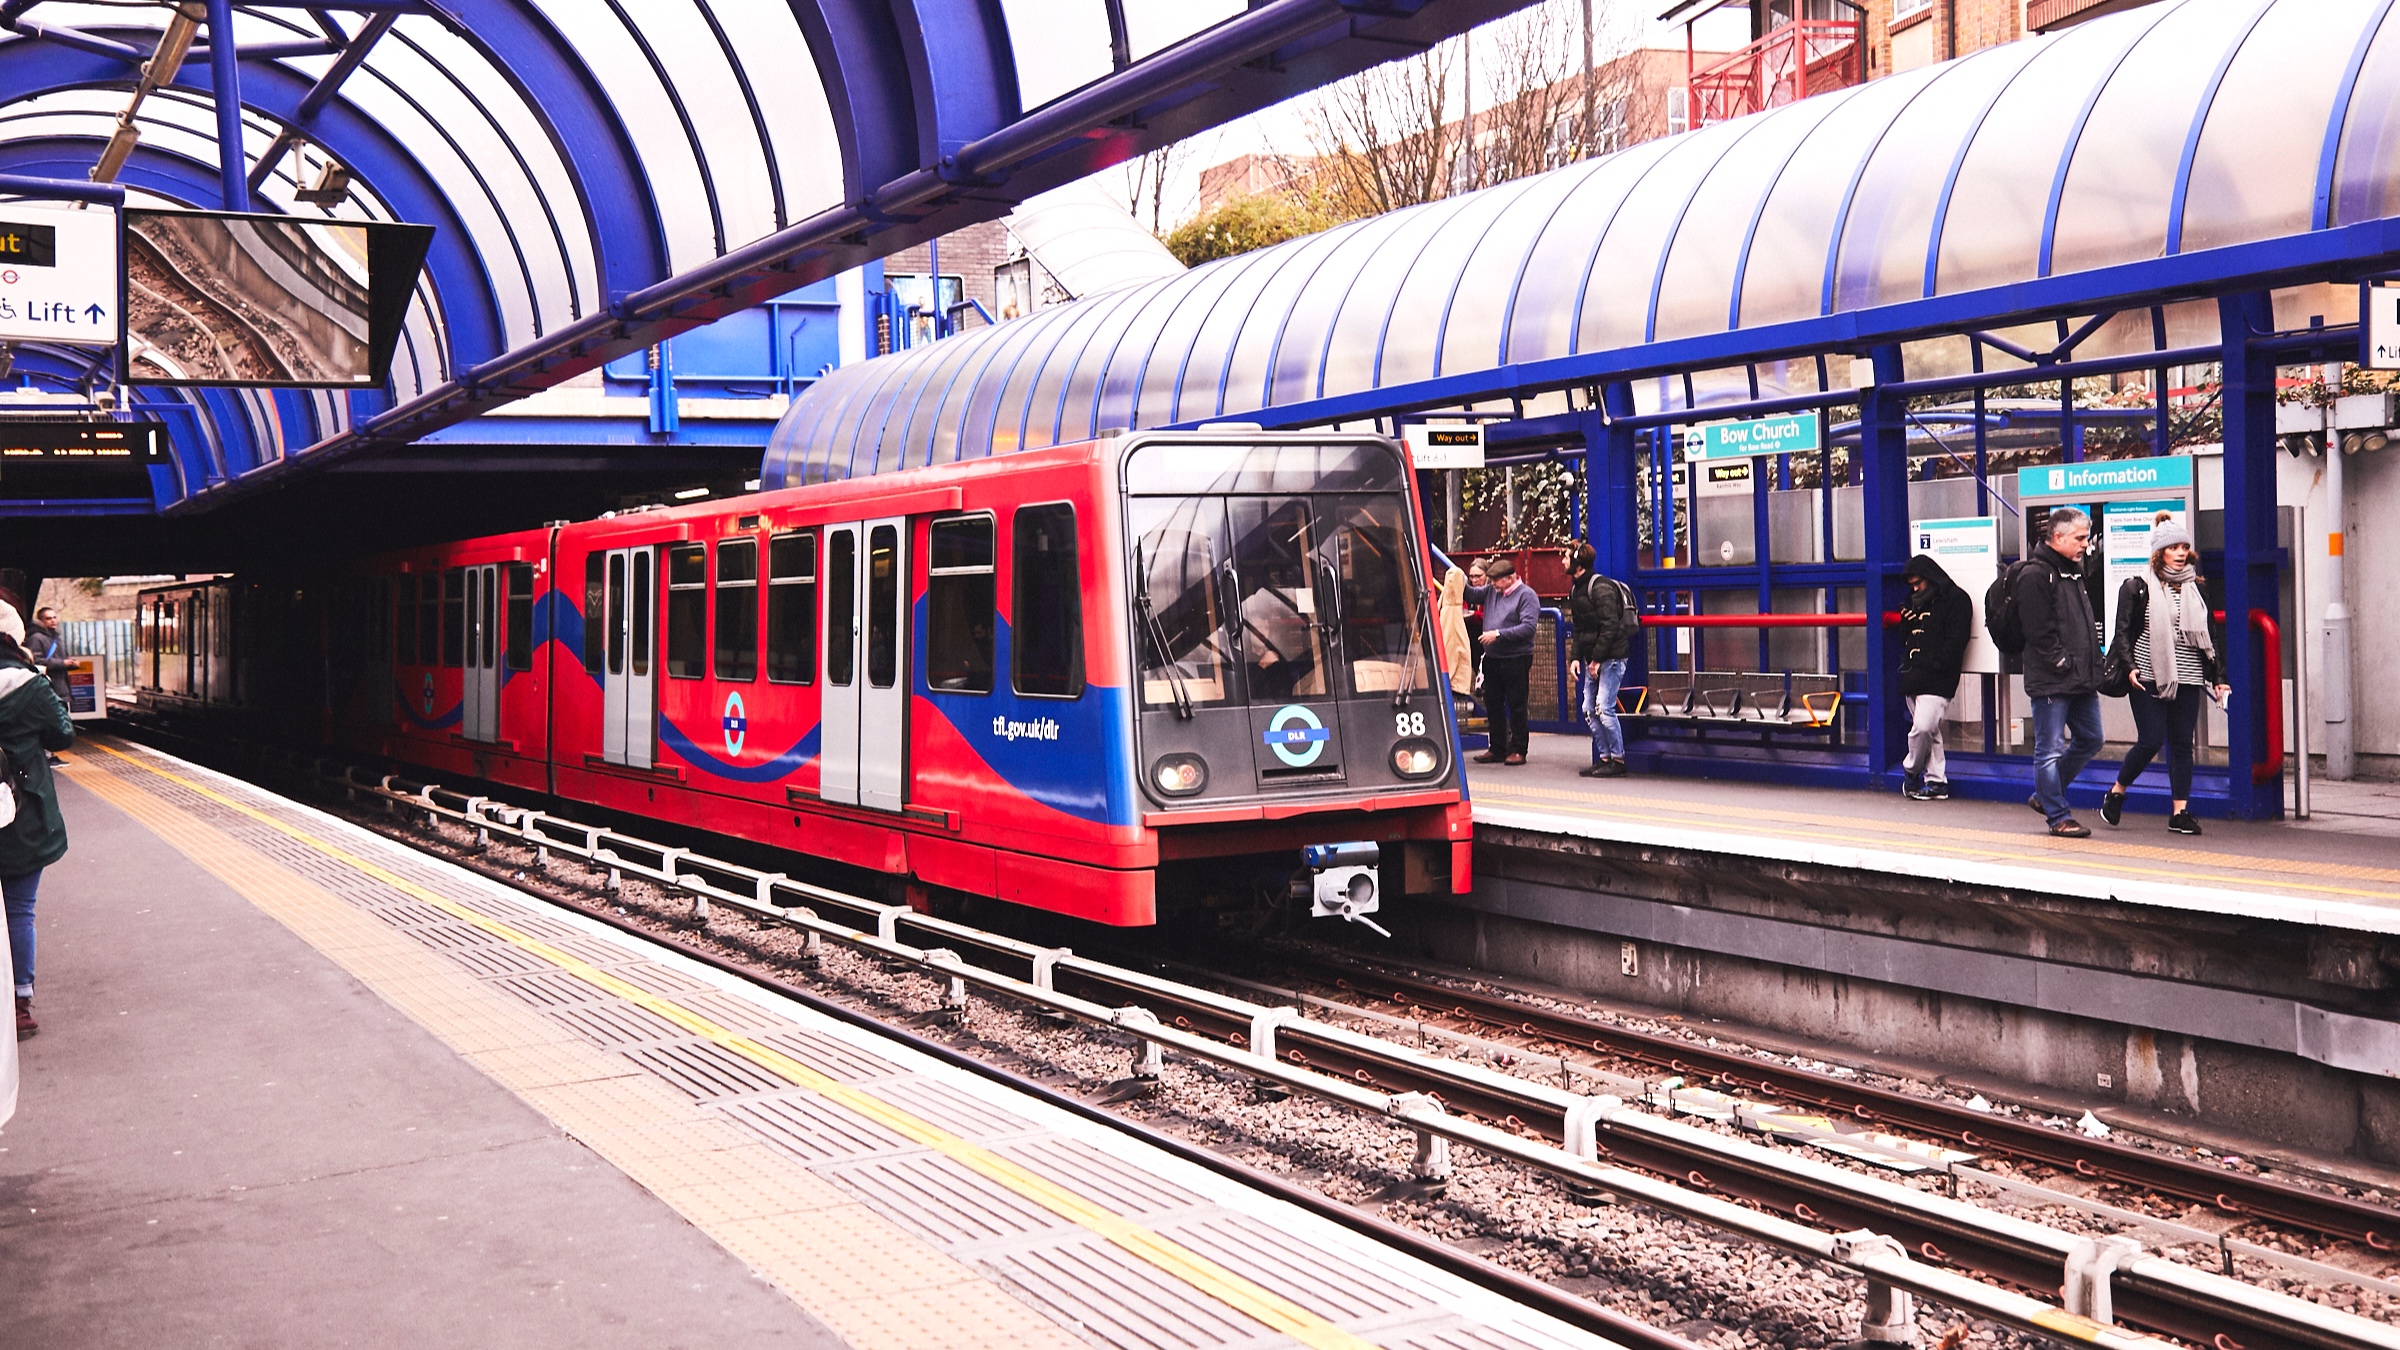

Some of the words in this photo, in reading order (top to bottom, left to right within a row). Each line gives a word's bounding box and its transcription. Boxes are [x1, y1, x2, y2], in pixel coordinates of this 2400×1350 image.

[28, 301, 76, 324] Lift
[1721, 427, 1748, 444] Bow
[1752, 420, 1799, 440] Church
[1437, 434, 1452, 443] Way
[1748, 443, 1760, 451] Bow
[1760, 441, 1774, 450] Road
[1416, 454, 1430, 462] Lift
[1715, 468, 1729, 479] Way
[1730, 467, 1742, 478] out
[2068, 466, 2157, 487] Information
[1922, 539, 1928, 549] 2
[992, 715, 1060, 741] tfl.gov.uk/dlr
[1395, 711, 1426, 737] 88
[1287, 731, 1306, 741] DLR
[1451, 823, 1458, 832] B
